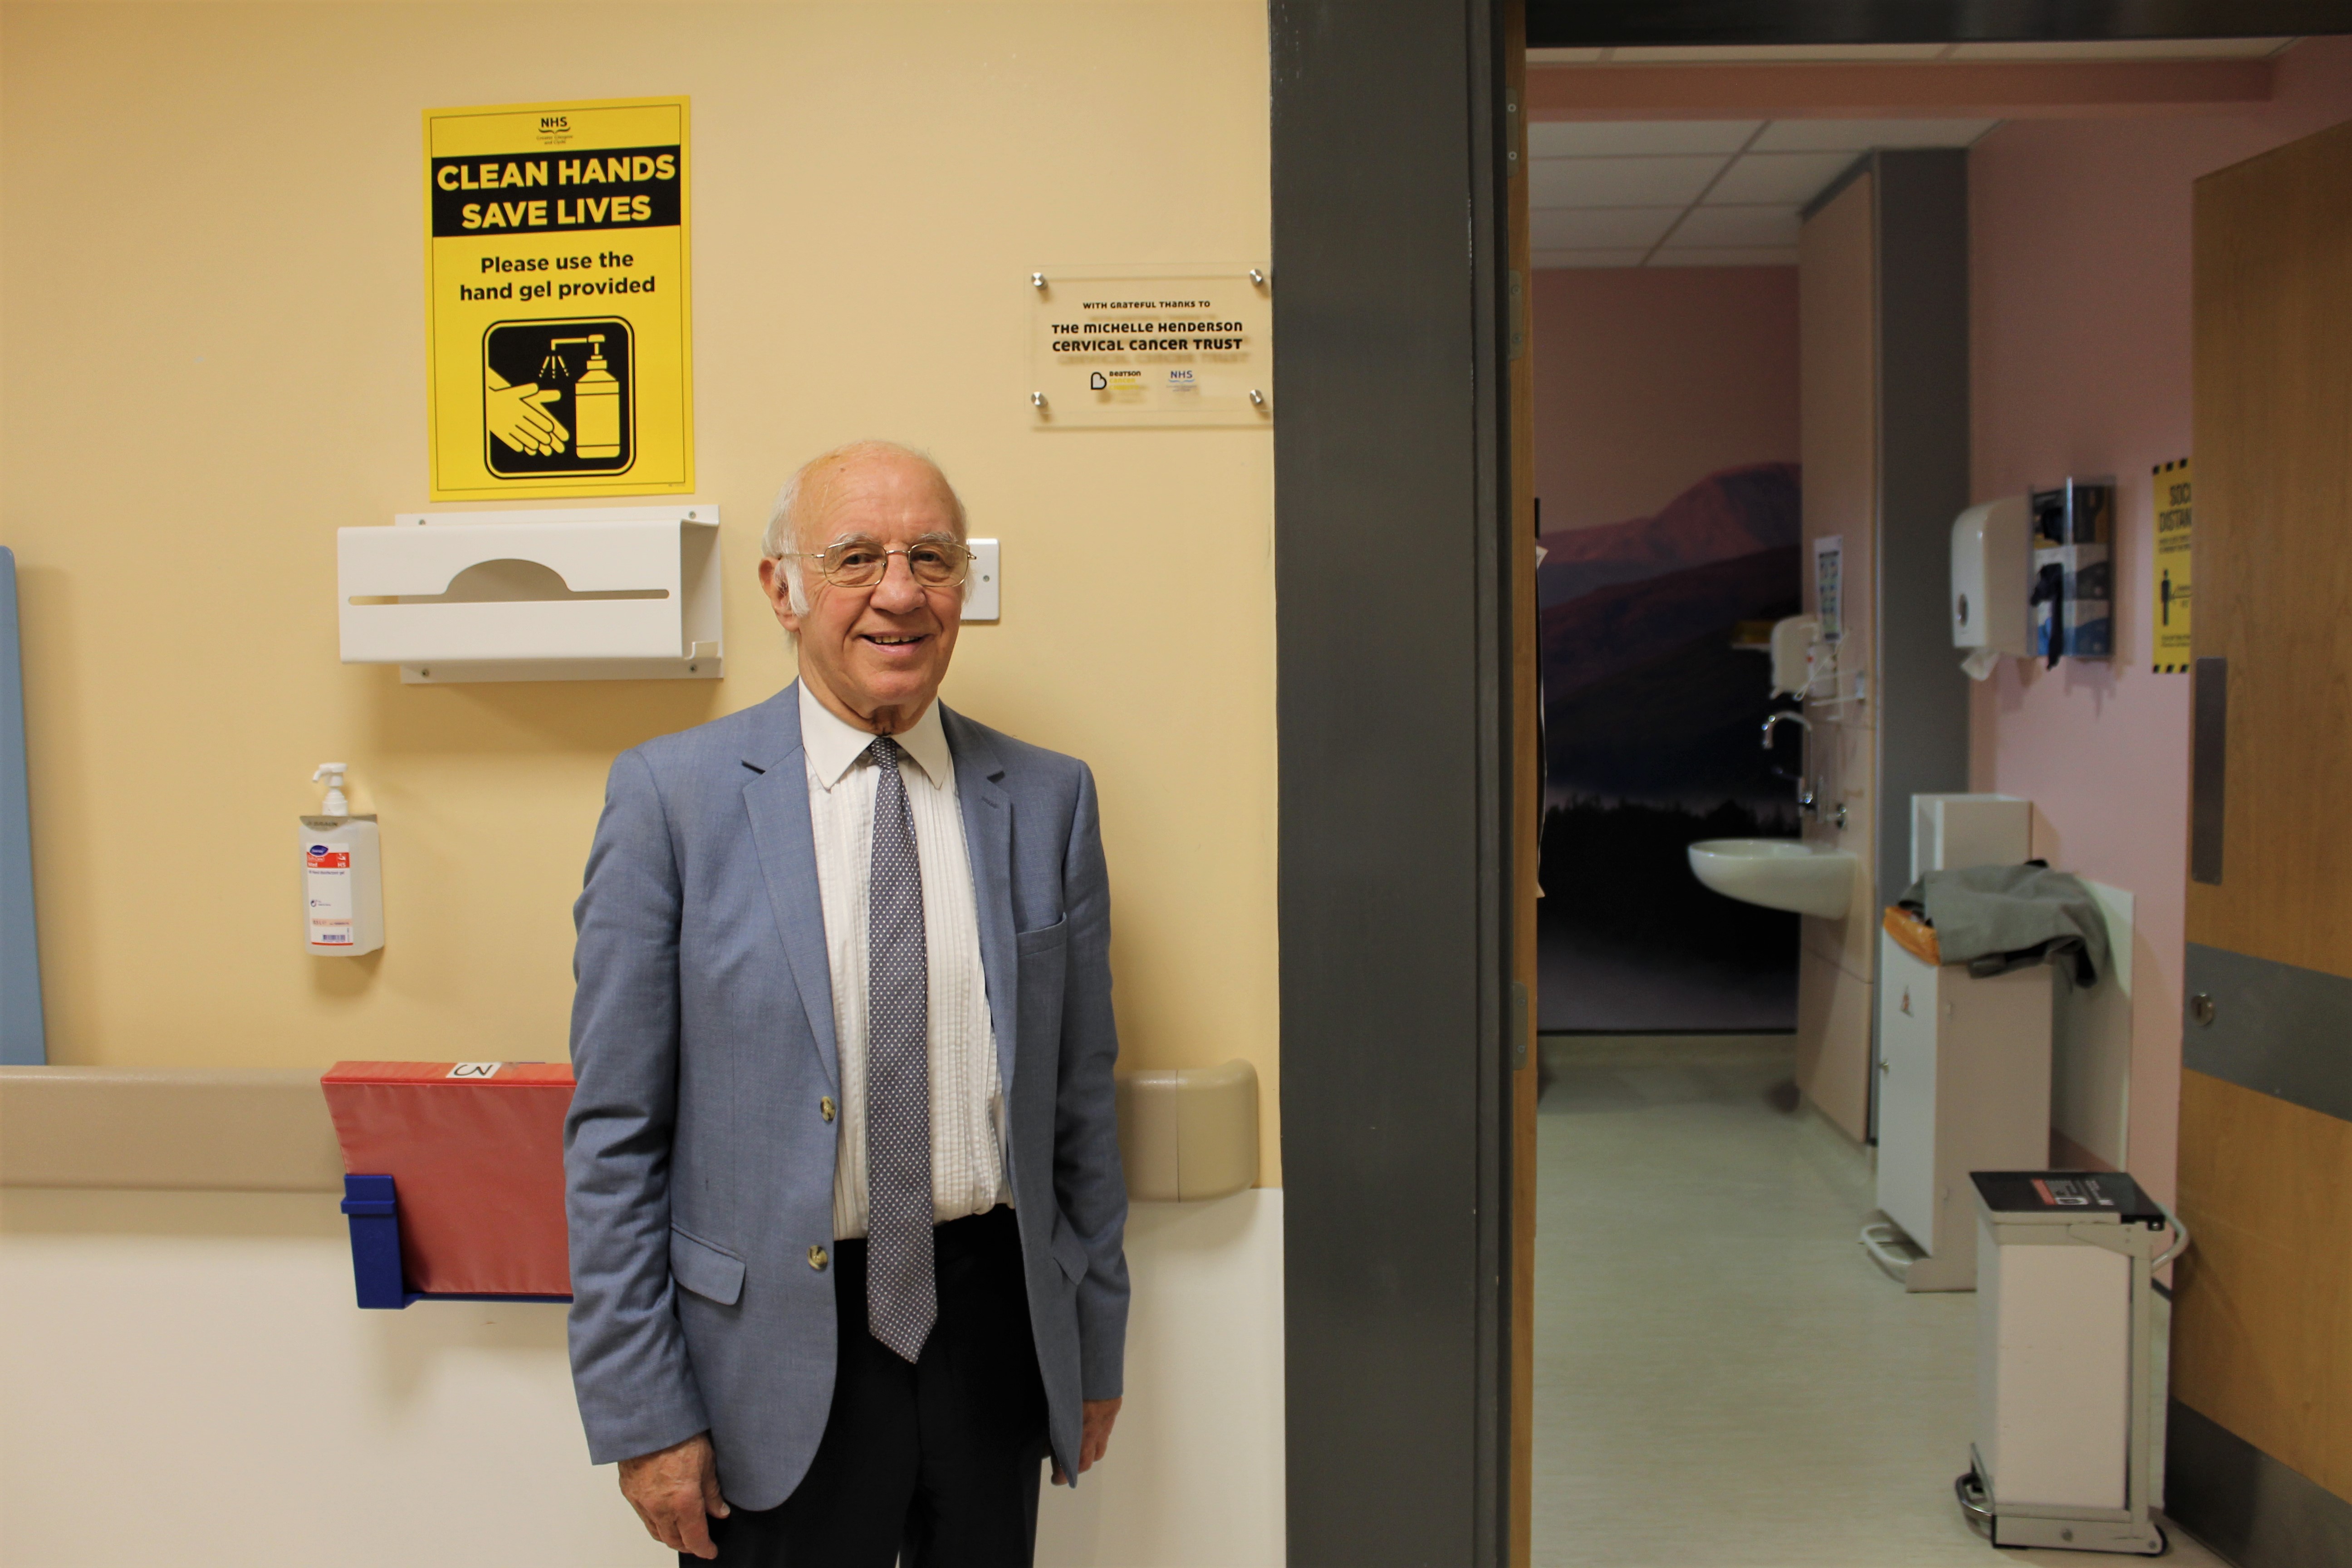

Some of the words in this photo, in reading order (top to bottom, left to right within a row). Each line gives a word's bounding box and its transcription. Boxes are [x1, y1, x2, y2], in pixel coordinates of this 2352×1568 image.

[541, 117, 567, 127] NHS
[437, 161, 548, 191] CLEAN
[559, 154, 675, 185] HANDS
[462, 200, 548, 229] SAVE
[557, 195, 651, 224] LIVES
[481, 256, 549, 273] Please
[556, 256, 592, 270] use
[598, 251, 633, 268] the
[461, 282, 512, 301] hand
[519, 280, 551, 301] gel
[559, 276, 655, 300] provided
[1052, 324, 1079, 334] THE
[1193, 338, 1243, 350] TRUST
[1171, 370, 1192, 378] NHS
